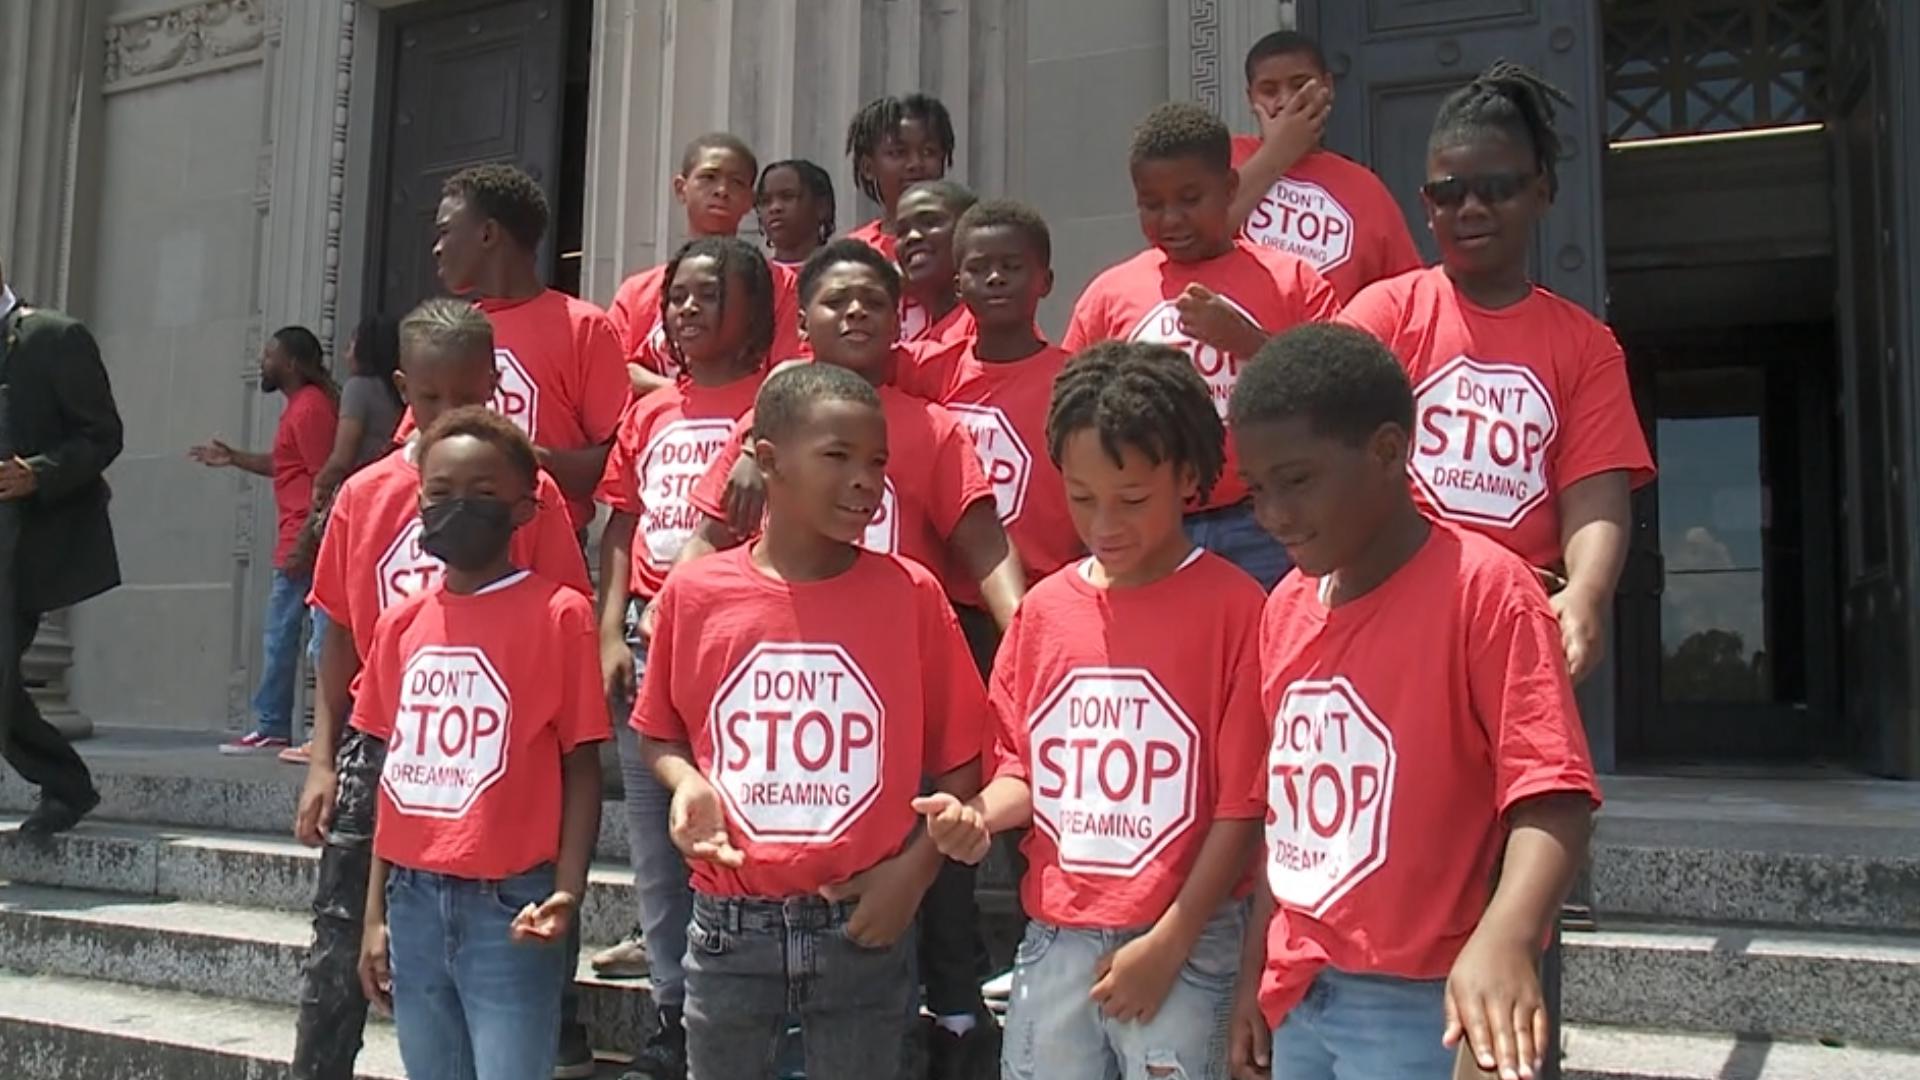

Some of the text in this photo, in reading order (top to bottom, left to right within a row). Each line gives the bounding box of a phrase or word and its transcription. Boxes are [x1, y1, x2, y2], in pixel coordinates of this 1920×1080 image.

[1277, 185, 1325, 210] DON'T
[1252, 198, 1344, 246] STOP
[1456, 363, 1529, 414] DON'T
[1419, 405, 1542, 473] STOP
[1432, 467, 1528, 501] DREAMING
[411, 670, 479, 698] DON'T
[754, 671, 844, 702] DON'T
[1070, 697, 1150, 730] DON'T
[727, 710, 875, 773] STOP
[391, 764, 475, 787] DREAMING
[1039, 738, 1182, 805] STOP
[1266, 764, 1379, 839] TOP
[1060, 811, 1153, 840] REAMING
